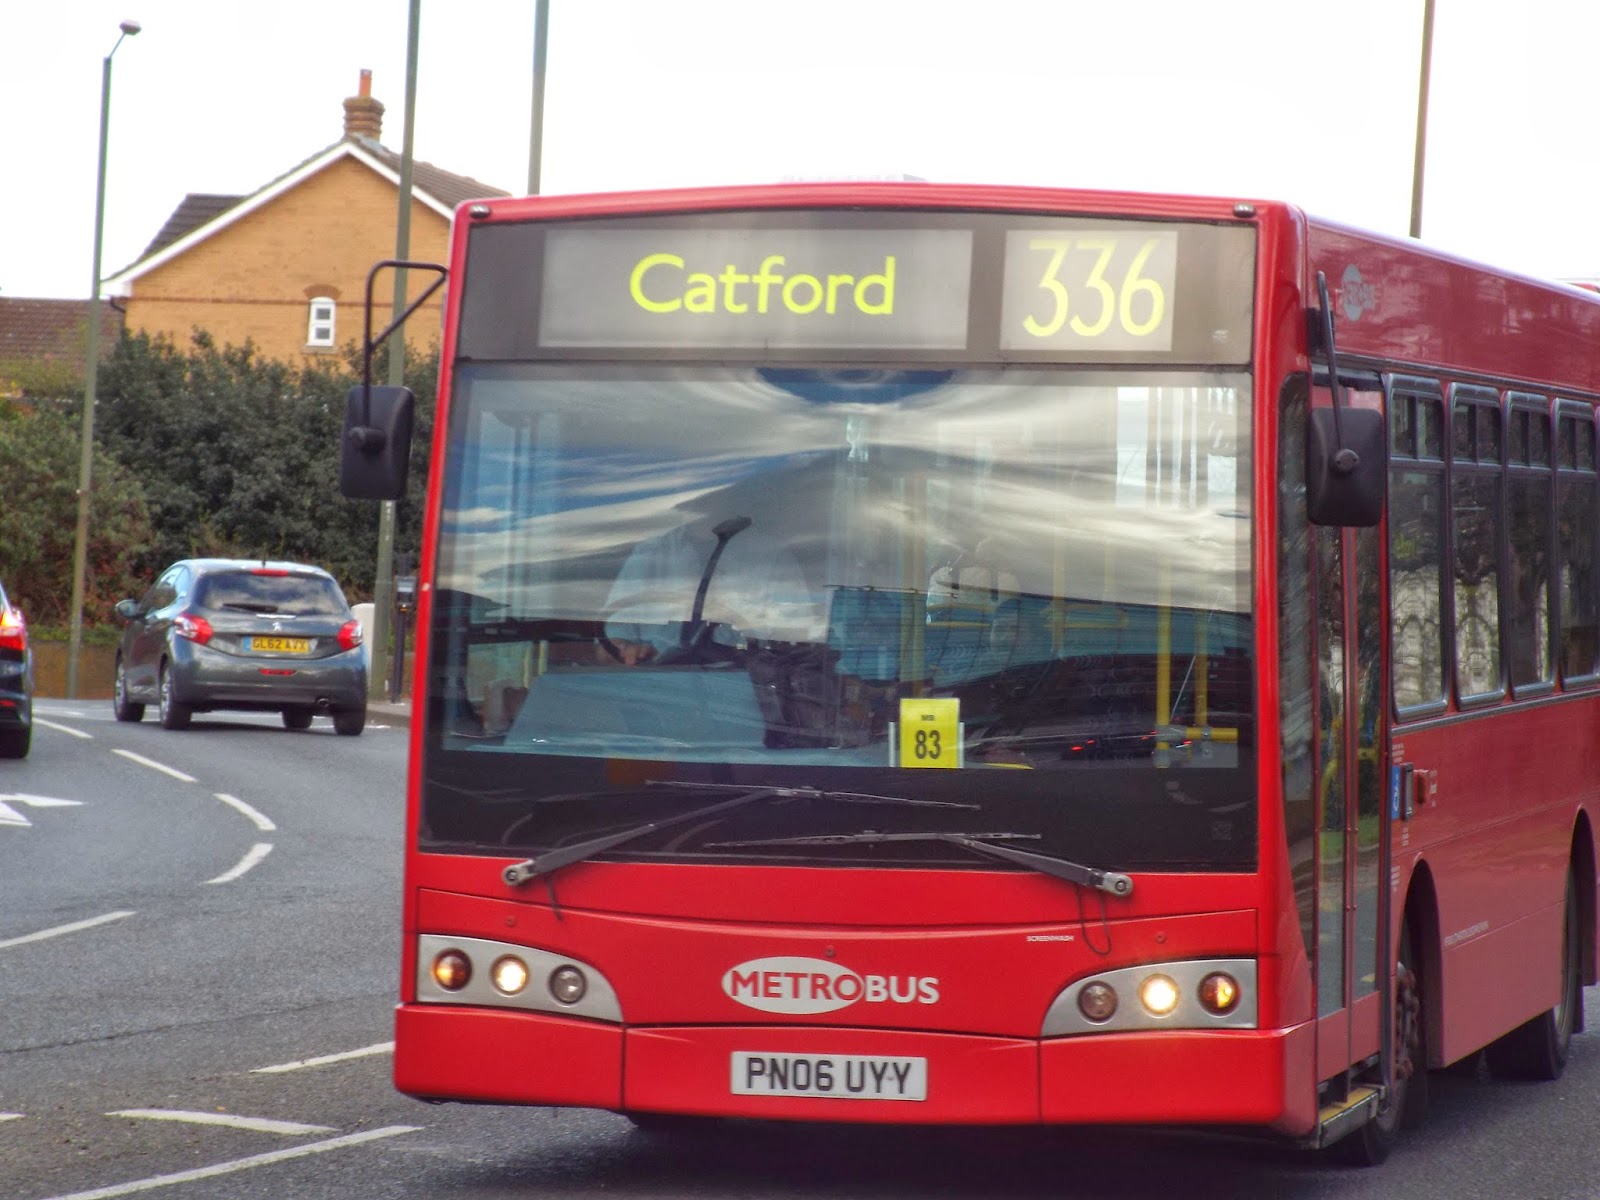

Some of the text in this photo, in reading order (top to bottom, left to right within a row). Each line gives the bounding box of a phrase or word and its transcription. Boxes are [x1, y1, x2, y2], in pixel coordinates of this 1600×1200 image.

[629, 253, 896, 316] Catford
[1022, 239, 1165, 337] 336
[252, 638, 306, 651] GL62 AVX
[915, 729, 941, 759] 83
[730, 969, 941, 1005] METROBUS
[746, 1056, 912, 1095] PN06 UYY
